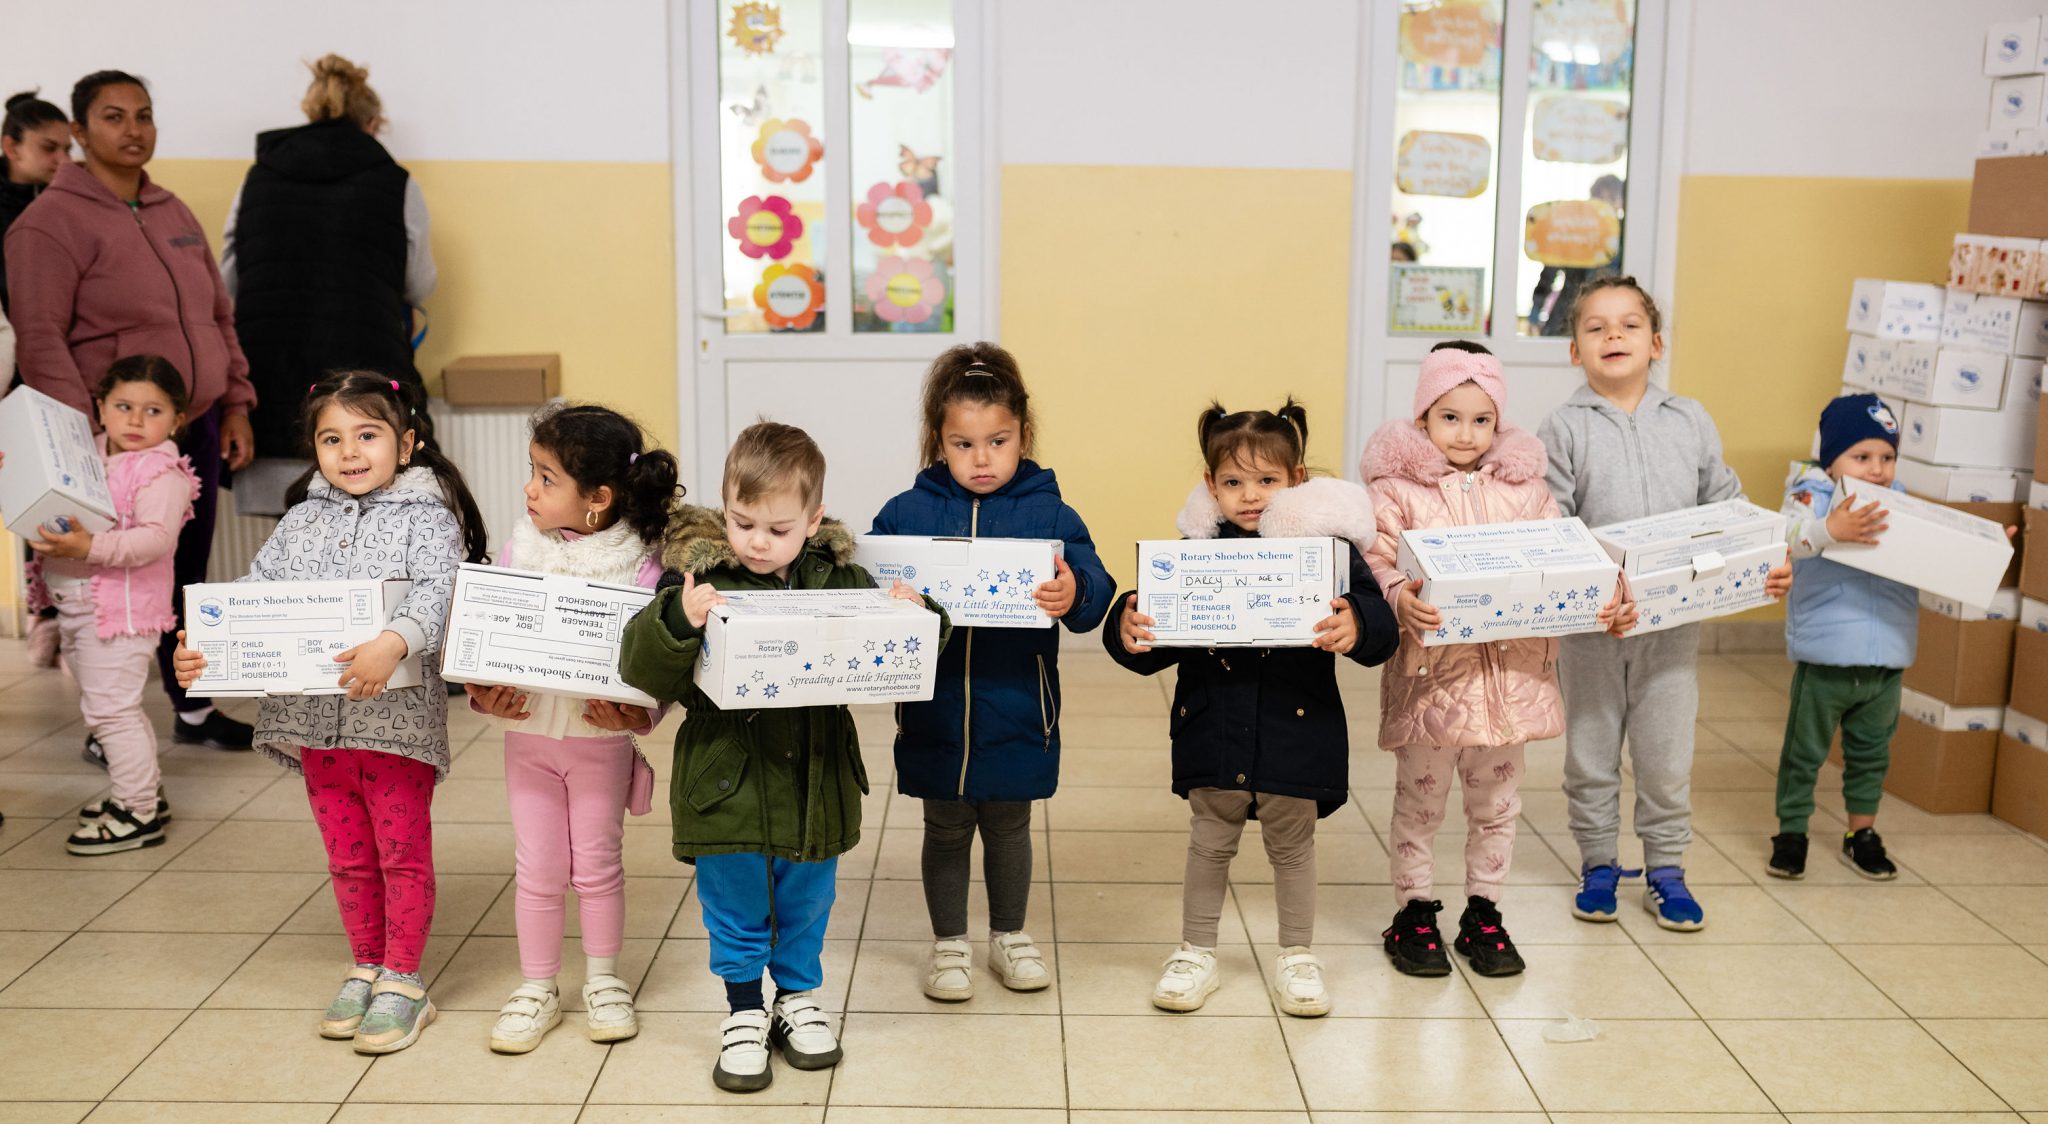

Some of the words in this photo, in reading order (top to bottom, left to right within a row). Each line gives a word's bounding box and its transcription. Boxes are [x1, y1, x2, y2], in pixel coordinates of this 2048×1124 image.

[1180, 552, 1212, 562] Rotary
[1215, 552, 1254, 561] Shoebox
[1257, 552, 1293, 560] Scheme
[229, 597, 260, 608] Rotary
[264, 596, 304, 604] Shoebox
[307, 594, 343, 603] Scheme
[558, 596, 607, 608] HOUSEHOLD
[963, 599, 988, 610] Little
[991, 600, 1037, 613] Happiness
[561, 617, 603, 628] TEENAGER
[1481, 618, 1523, 630] Spreading
[1532, 615, 1556, 624] Little
[486, 660, 525, 673] Scheme
[528, 666, 571, 680] Shoebox
[577, 670, 609, 685] Rotary
[788, 674, 835, 686] Spreading
[846, 673, 873, 683] Little
[874, 672, 922, 684] Happiness
[846, 684, 920, 693] www.rotaryshoebox.org
